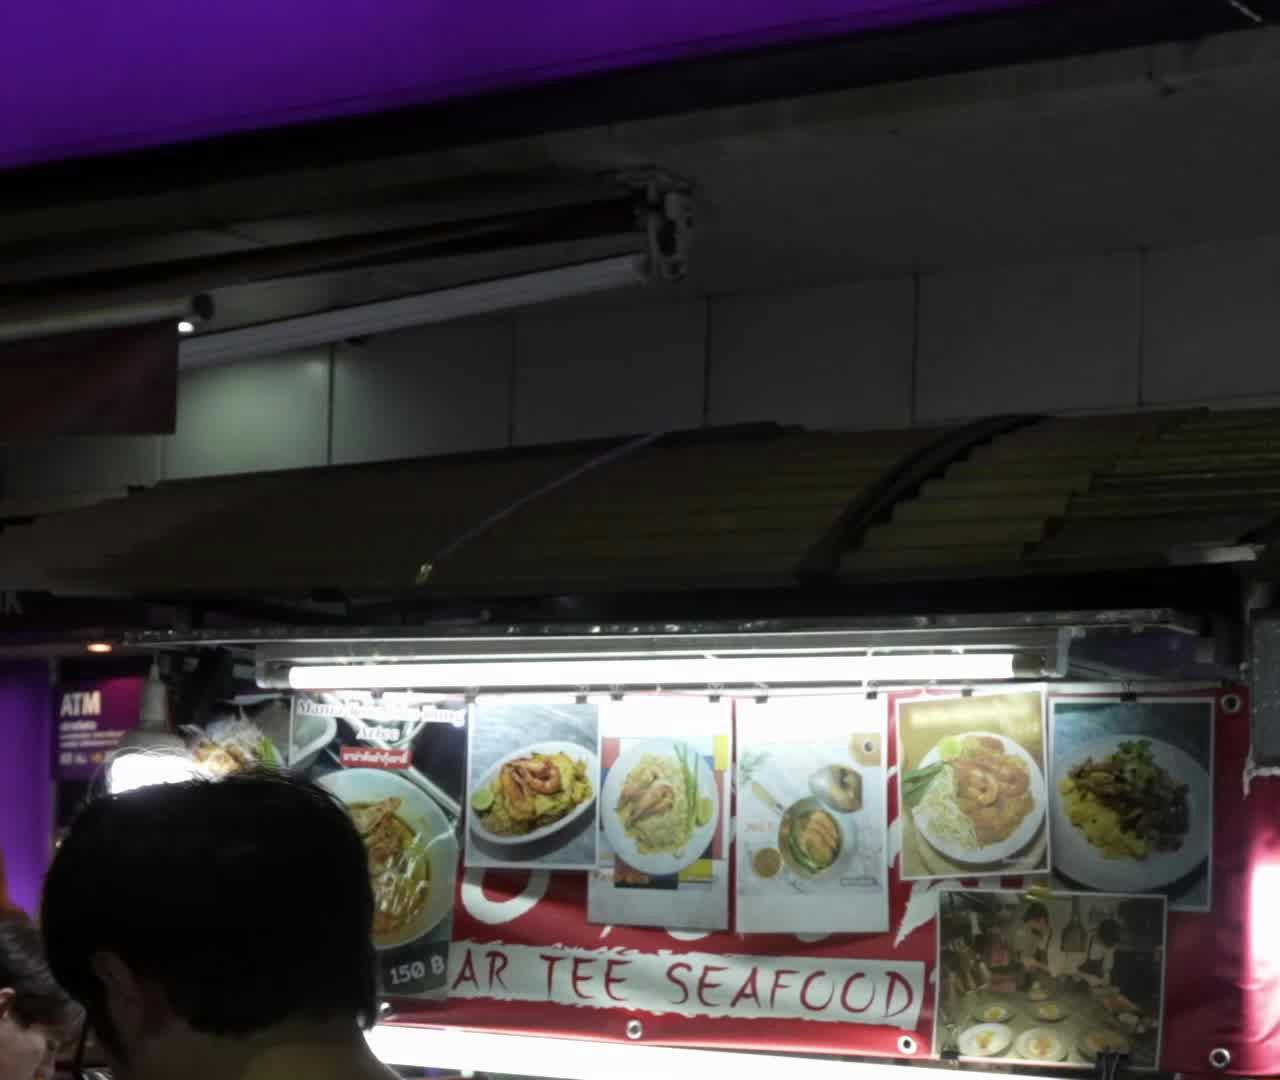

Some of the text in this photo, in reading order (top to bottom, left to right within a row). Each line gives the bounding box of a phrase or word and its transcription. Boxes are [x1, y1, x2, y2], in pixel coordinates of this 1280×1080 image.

[60, 690, 102, 717] ATM
[391, 960, 425, 985] 150
[451, 948, 915, 1018] AR TEE SEAFOOD
